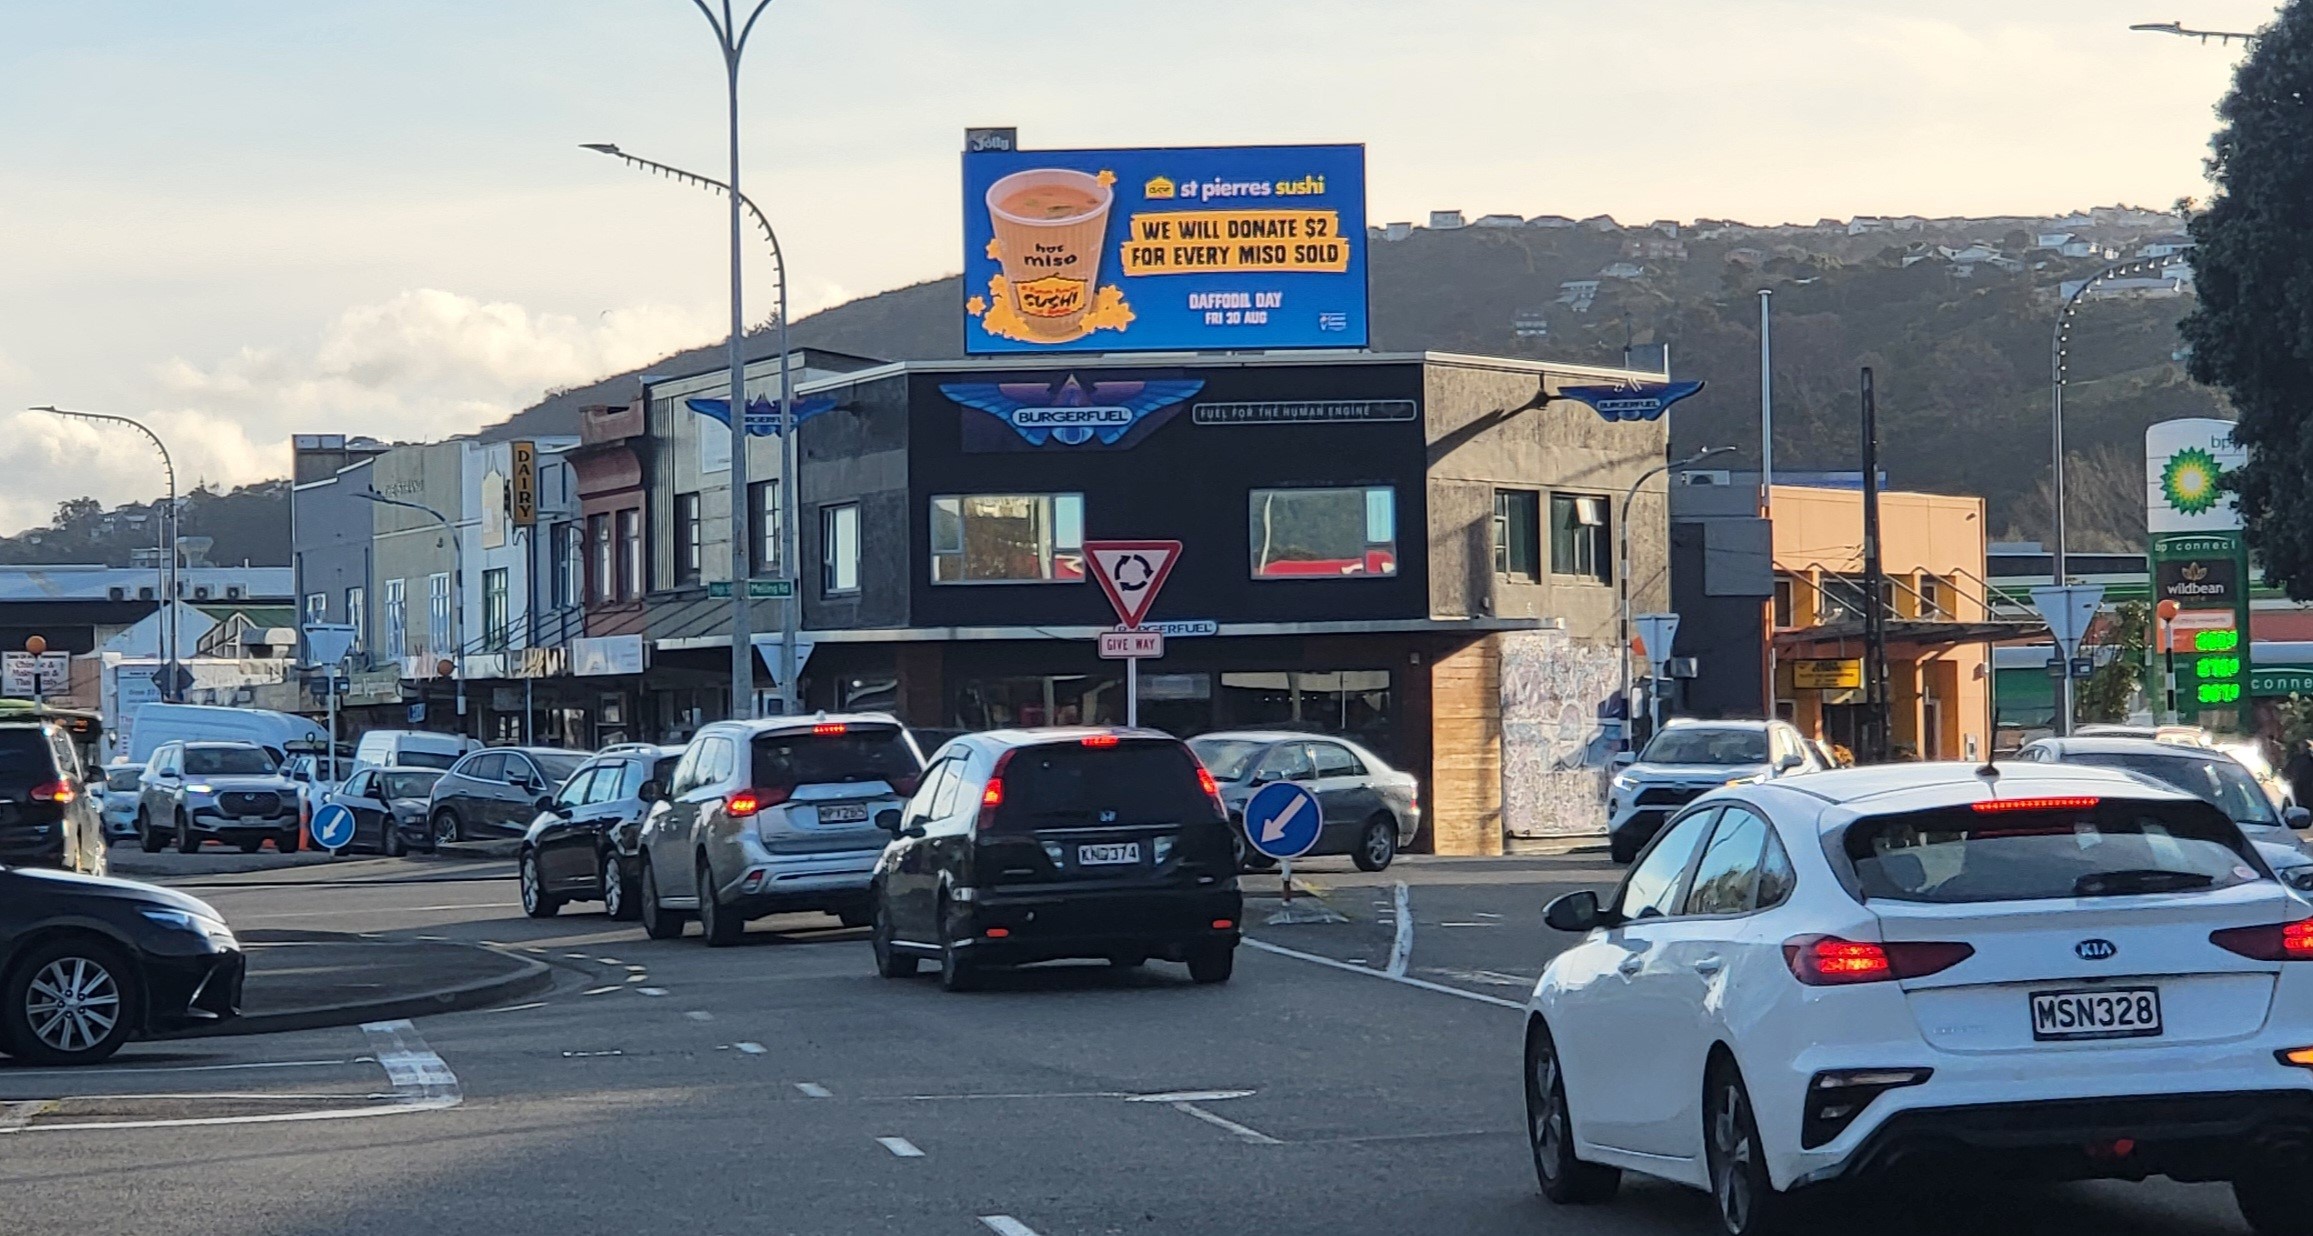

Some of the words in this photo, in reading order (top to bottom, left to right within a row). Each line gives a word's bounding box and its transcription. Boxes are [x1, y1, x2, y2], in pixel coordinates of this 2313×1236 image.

[973, 136, 1010, 151] Jolly
[1180, 180, 1196, 197] st
[1202, 177, 1271, 202] pierres
[1275, 175, 1325, 196] sushi
[1142, 221, 1170, 240] WE
[1178, 220, 1220, 239] WILL
[1228, 219, 1297, 239] DONATE
[1305, 217, 1328, 240] $2
[1024, 254, 1078, 267] miso
[1132, 247, 1165, 266] FOR
[1174, 246, 1230, 265] EVERY
[1239, 245, 1286, 265] MISO
[1295, 244, 1338, 263] SOLD
[1188, 293, 1252, 310] DAFFODIL
[1255, 292, 1283, 309] DAY
[1204, 312, 1223, 325] FRI
[1226, 312, 1241, 325] 30
[1244, 311, 1268, 325] AUG
[1018, 410, 1129, 423] BURGERFUEL
[1200, 405, 1227, 419] FUEL
[1232, 404, 1252, 417] FOR
[1258, 404, 1279, 417] THE
[1283, 402, 1324, 416] HUMAN
[1328, 401, 1371, 415] ENGINE
[517, 450, 531, 518] DAIRY
[2155, 543, 2168, 552] bp
[751, 582, 777, 596] Melling
[2167, 583, 2224, 595] wildbean
[1107, 638, 1128, 651] GIVE
[1136, 638, 1155, 651] WAY
[2080, 943, 2113, 957] KIA
[2037, 996, 2153, 1029] MSN328
